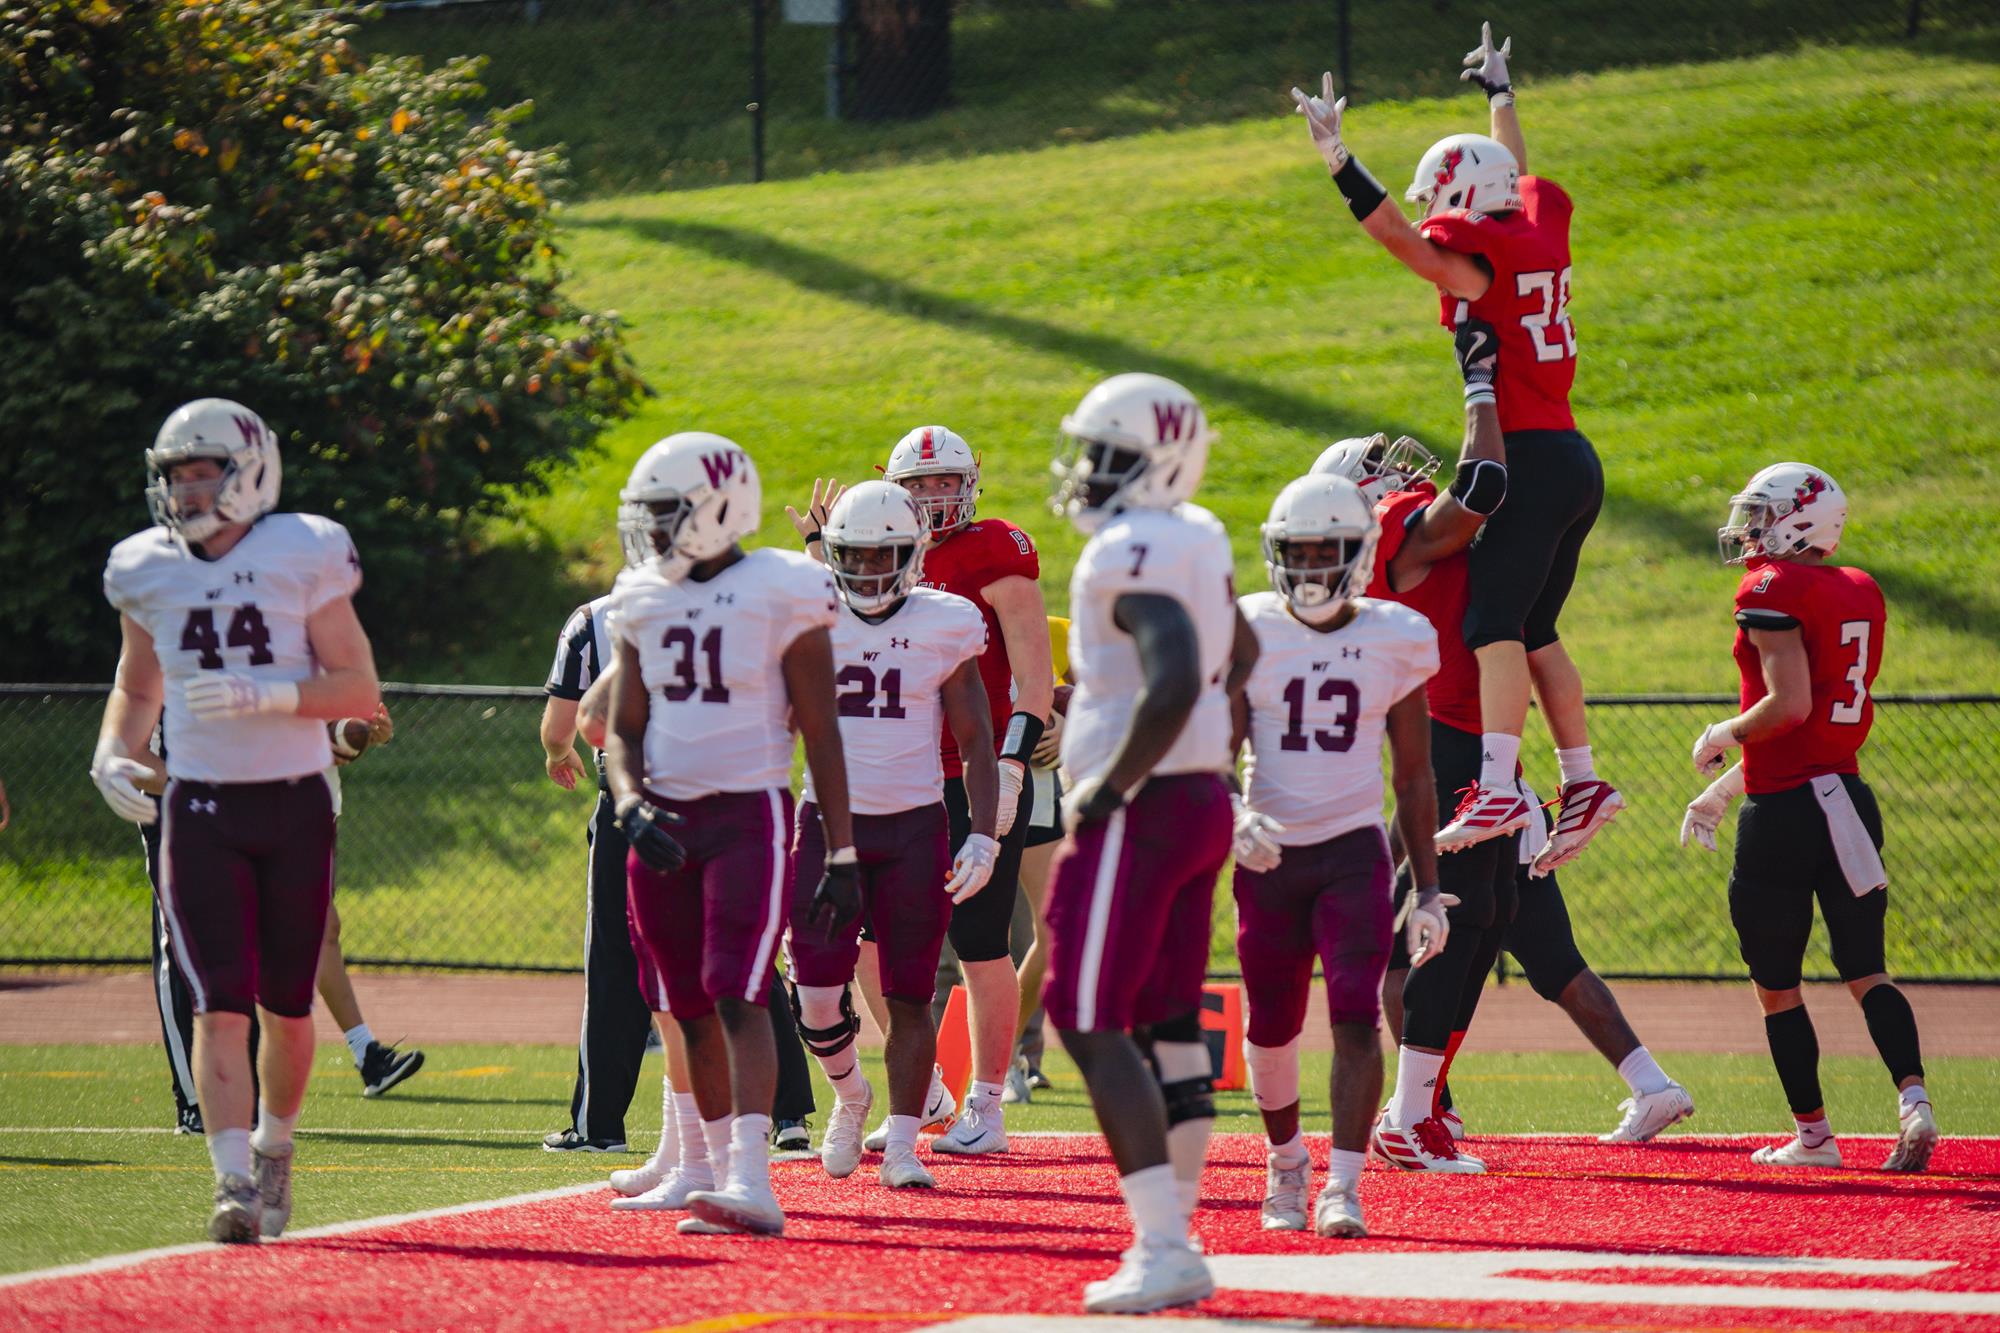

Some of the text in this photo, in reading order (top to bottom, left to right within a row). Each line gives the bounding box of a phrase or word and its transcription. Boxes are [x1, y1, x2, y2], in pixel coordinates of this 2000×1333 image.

[1129, 544, 1149, 577] 7
[1752, 571, 1776, 593] 3
[179, 602, 274, 669] 44
[863, 651, 881, 662] WT
[662, 624, 730, 703] 31
[1312, 661, 1330, 672] WT
[1829, 619, 1871, 724] 3
[836, 665, 906, 719] 21
[1281, 676, 1361, 753] 13
